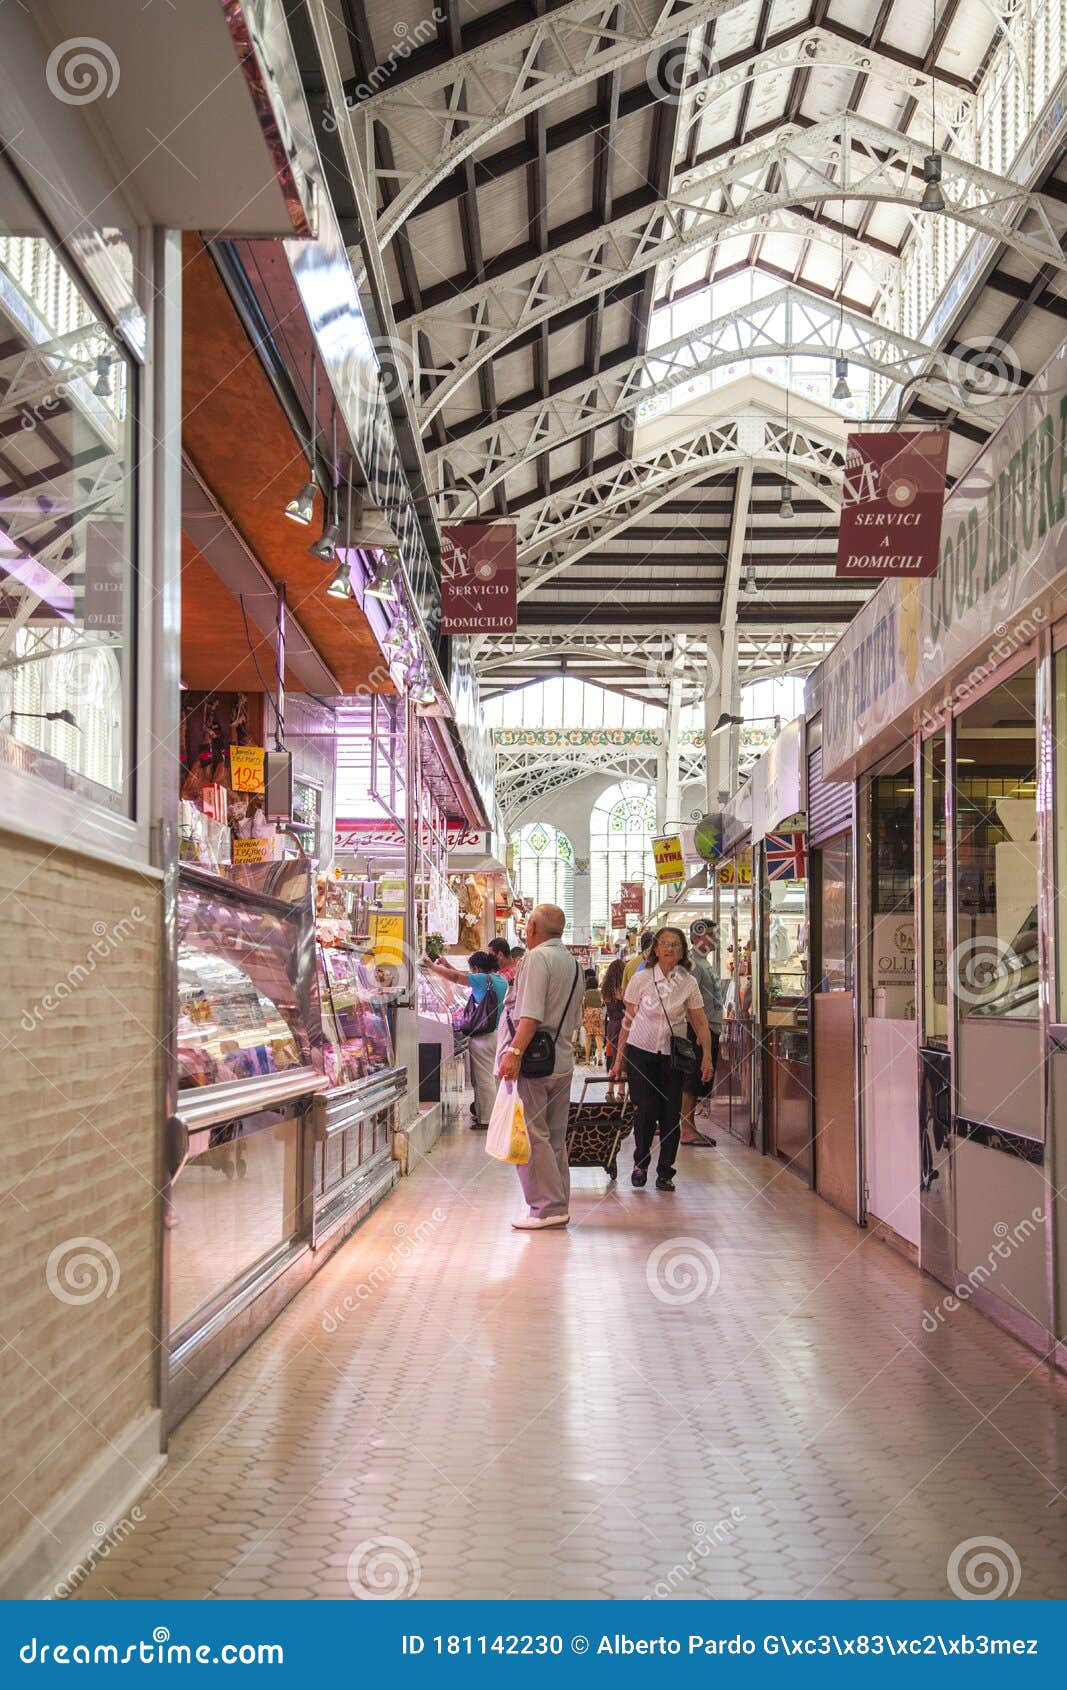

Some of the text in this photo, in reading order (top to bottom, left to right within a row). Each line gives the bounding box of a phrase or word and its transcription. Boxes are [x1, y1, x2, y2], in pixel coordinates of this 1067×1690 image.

[854, 513, 922, 526] SERVICI
[879, 535, 890, 547] A
[845, 555, 924, 569] DOMICILI
[448, 585, 509, 596] SERVICIO
[475, 602, 483, 611] A
[444, 616, 514, 628] DOMICILIO
